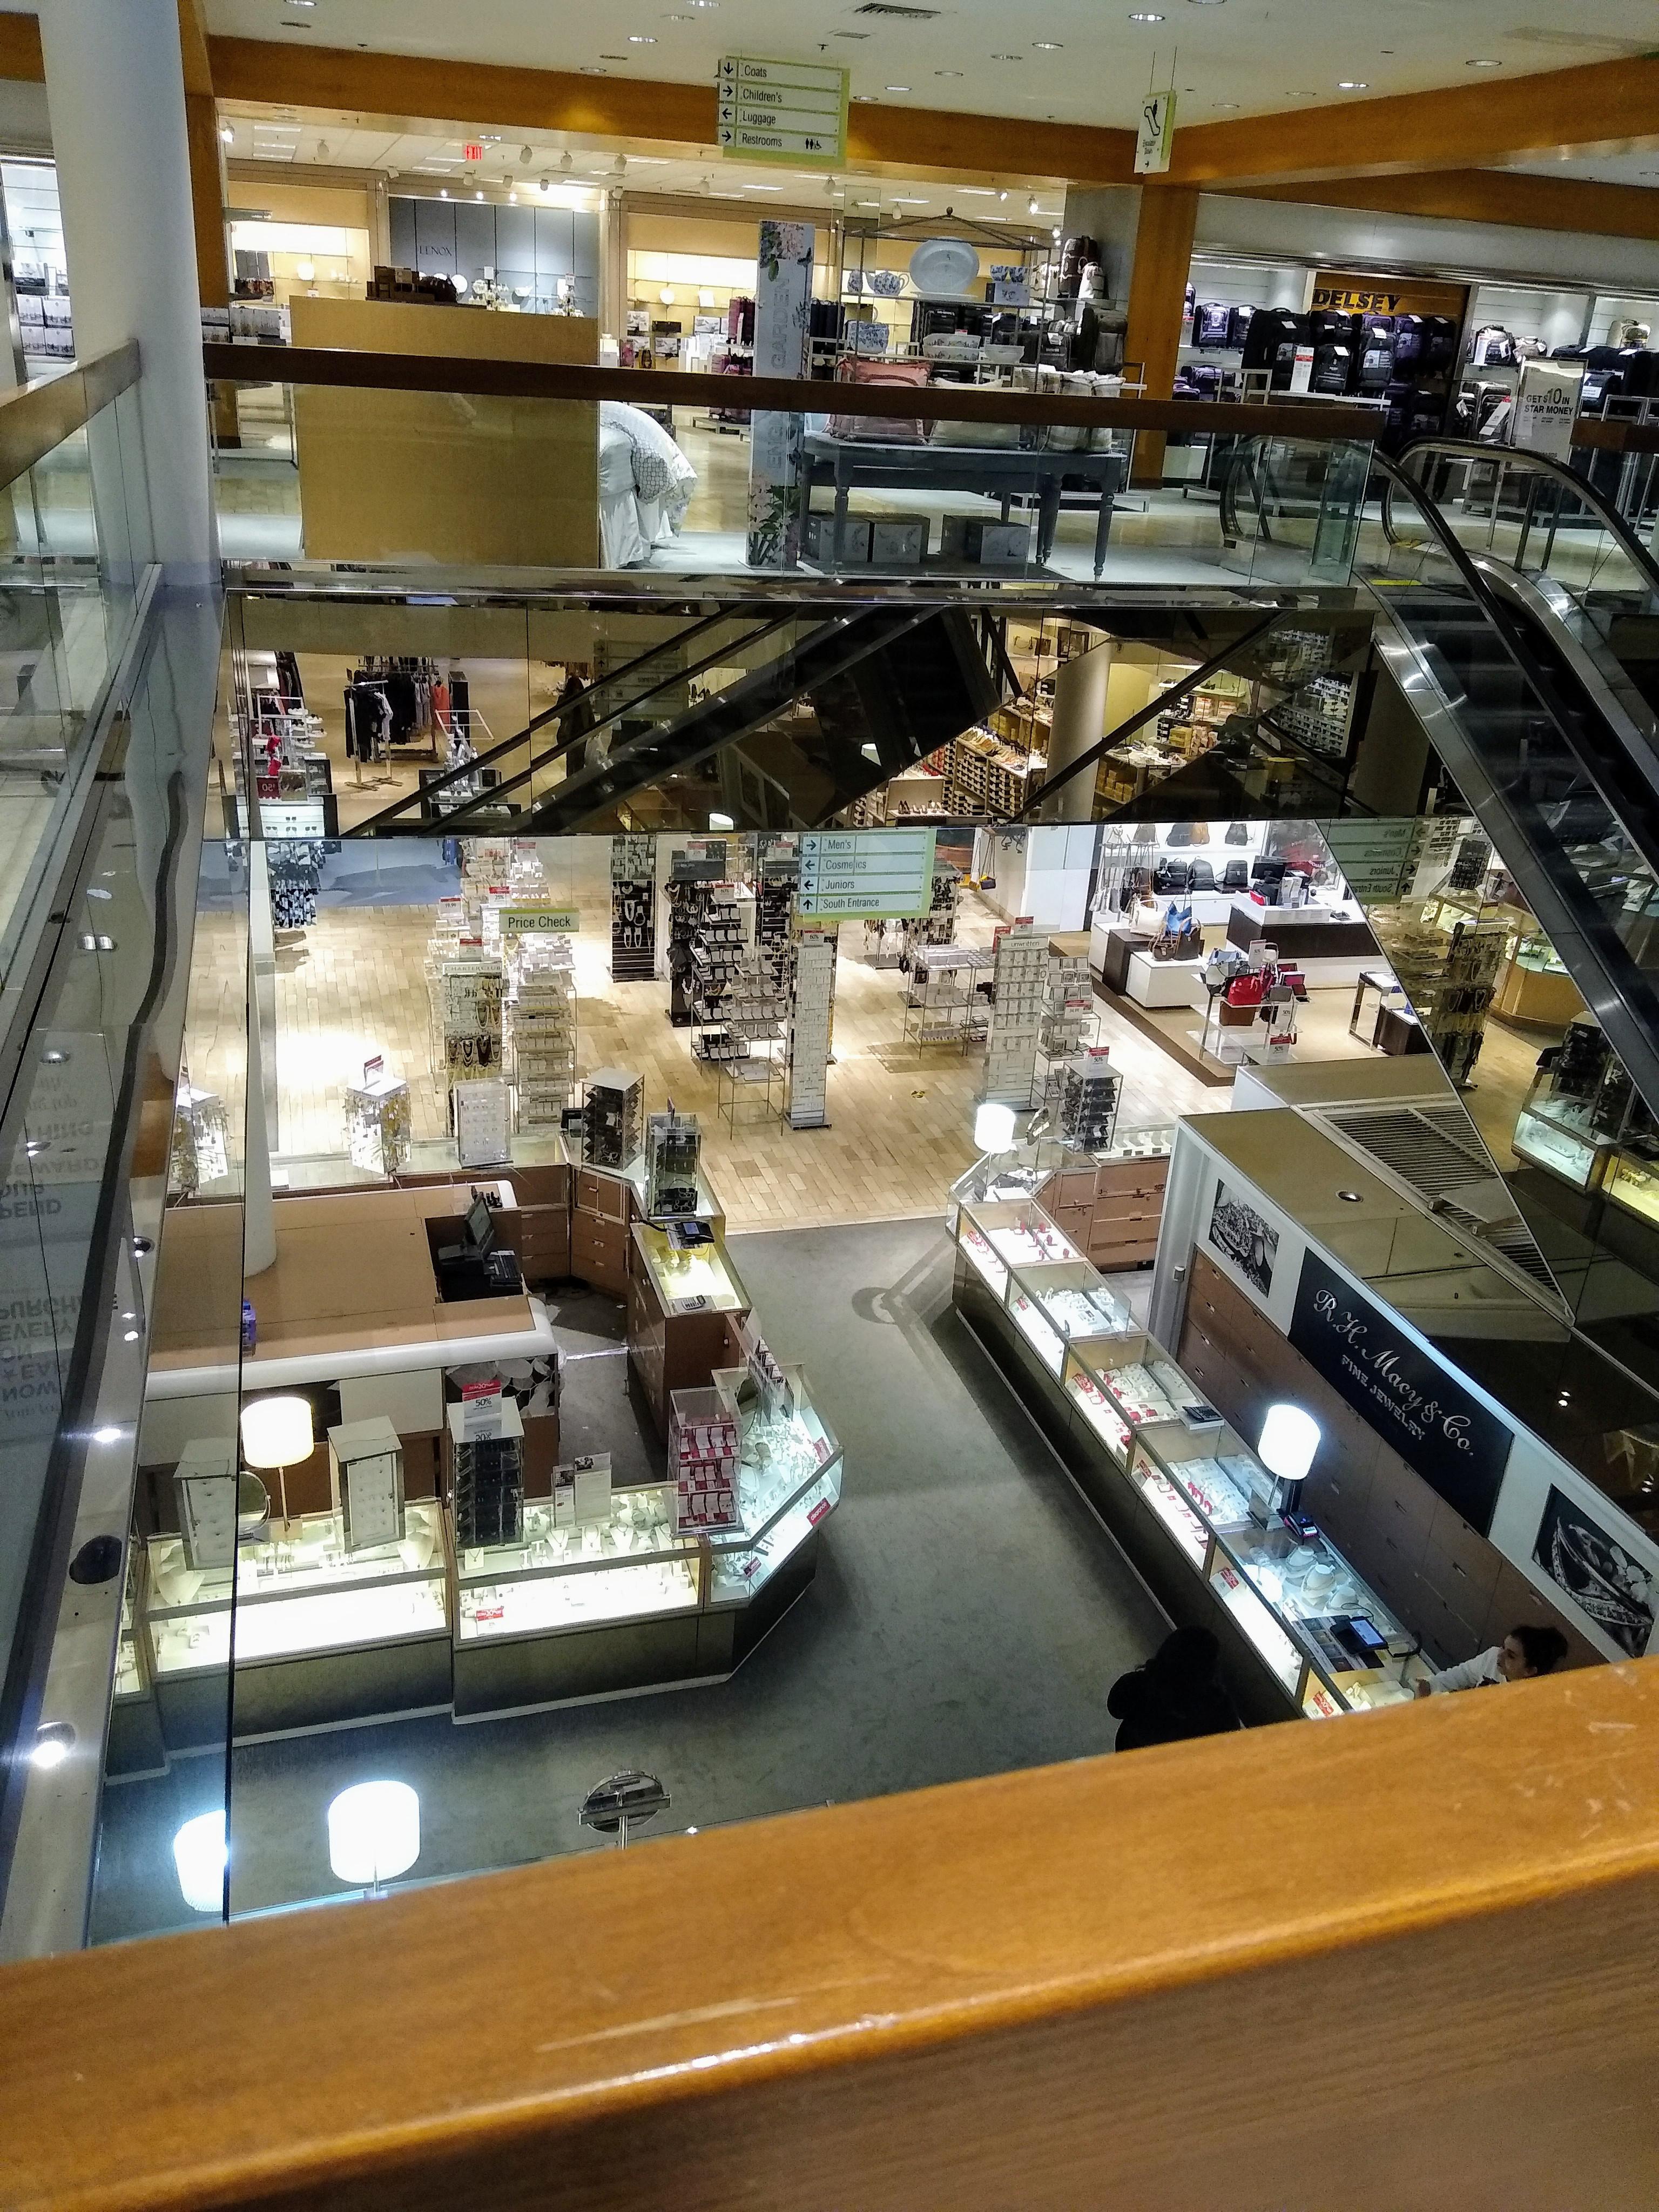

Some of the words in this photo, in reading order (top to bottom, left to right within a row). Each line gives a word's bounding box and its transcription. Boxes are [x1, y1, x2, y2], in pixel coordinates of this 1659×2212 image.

[744, 65, 767, 78] Coats
[743, 89, 782, 103] Children's
[743, 111, 776, 125] Luggage
[742, 133, 782, 146] Restrooms
[1312, 289, 1401, 312] DELSEY
[771, 278, 790, 369] GARDEN
[1527, 395, 1542, 403] GET
[1524, 405, 1544, 413] STAR
[1546, 406, 1573, 415] MONEY
[828, 839, 851, 849] Men's
[825, 880, 855, 889] Juniors
[823, 899, 845, 908] South
[847, 898, 879, 908] Entrance
[508, 917, 535, 928] Price
[538, 916, 571, 927] Check
[475, 1398, 492, 1407] 50%
[1341, 1354, 1368, 1387] FINE
[1370, 1385, 1426, 1440] JEWELRY
[1361, 1350, 1423, 1411] Macy
[1421, 1401, 1442, 1423] &
[1441, 1415, 1474, 1456] Co.
